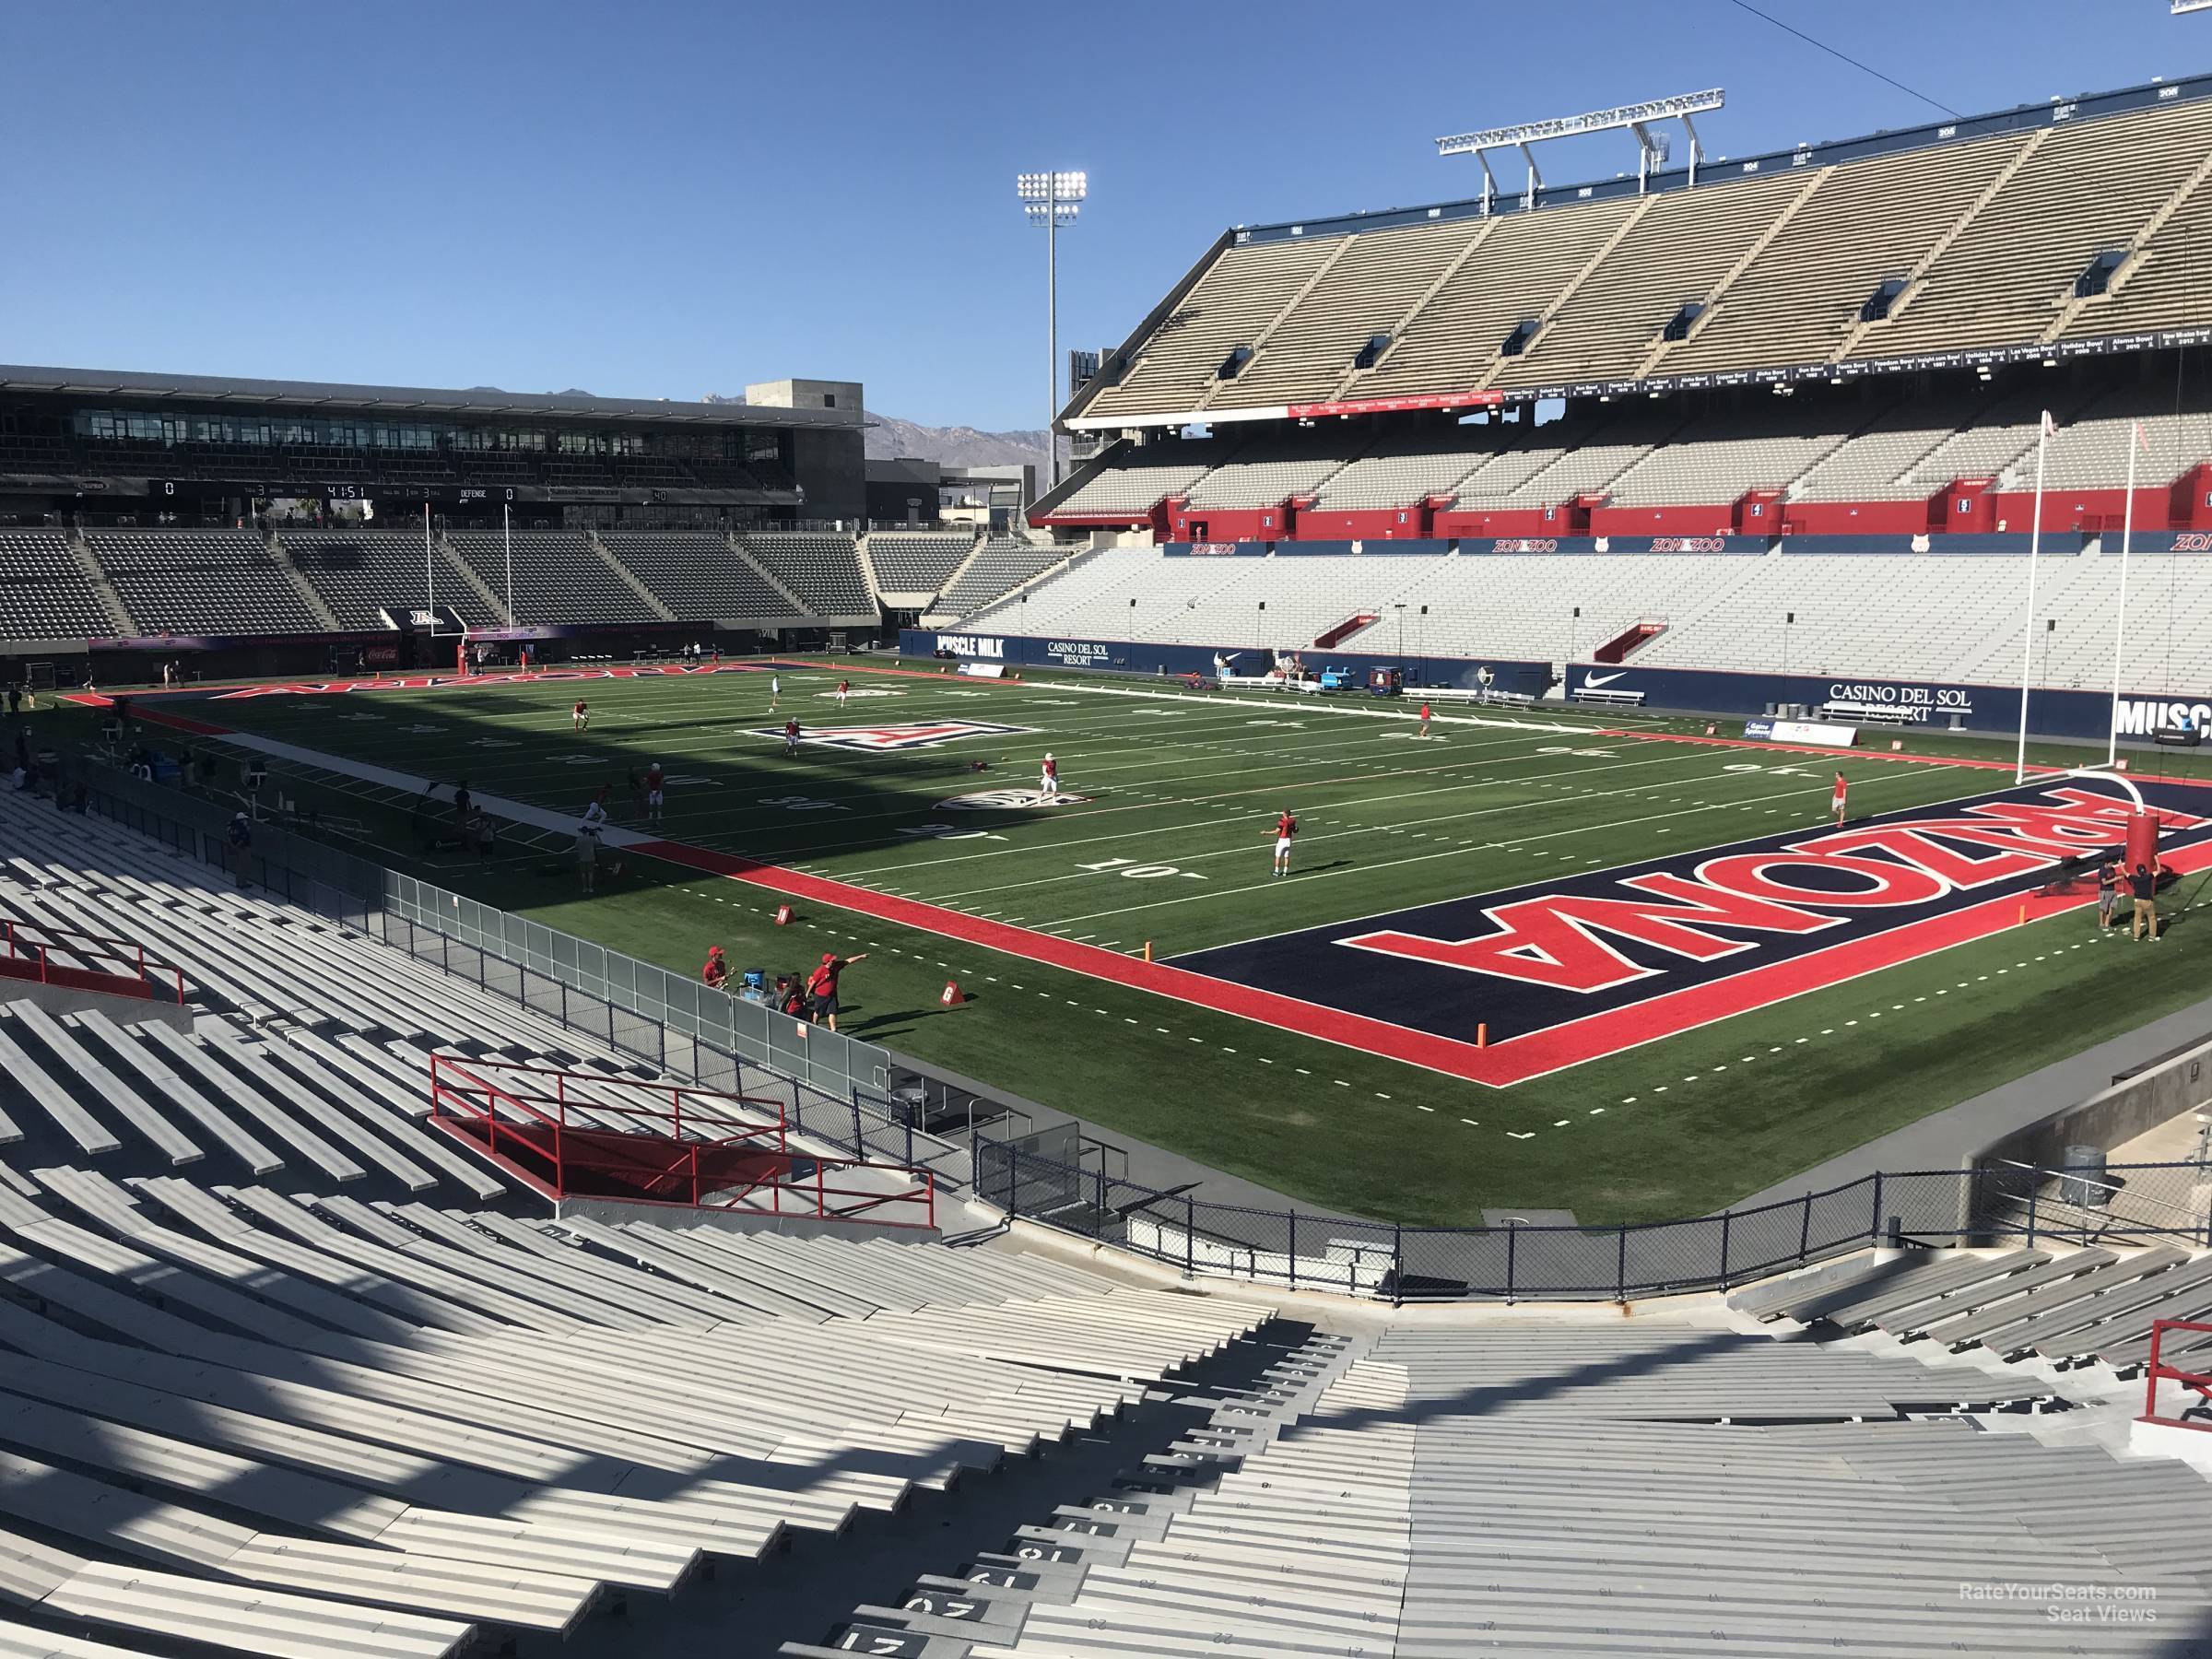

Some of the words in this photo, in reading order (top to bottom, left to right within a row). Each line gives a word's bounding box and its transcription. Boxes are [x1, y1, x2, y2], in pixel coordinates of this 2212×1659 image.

[166, 482, 173, 495] 0
[327, 486, 364, 498] 41:51
[461, 489, 487, 498] DEFENSE
[506, 488, 513, 500] 0
[936, 636, 977, 657] MUSCLE
[978, 638, 1005, 658] MILK
[1048, 641, 1077, 653] CASINO
[1078, 644, 1092, 655] DEL
[1093, 645, 1109, 656] SOL
[1064, 653, 1093, 666] RESORT
[1830, 684, 1897, 702] CASINO
[1900, 688, 1935, 705] DEL
[1936, 689, 1971, 707] SOL
[2115, 700, 2212, 739] MUSC
[1745, 727, 1771, 735] Sponsor
[1074, 858, 1180, 878] 10
[1333, 787, 2212, 994] ARIZONA
[777, 908, 788, 923] 10
[942, 985, 954, 1003] G
